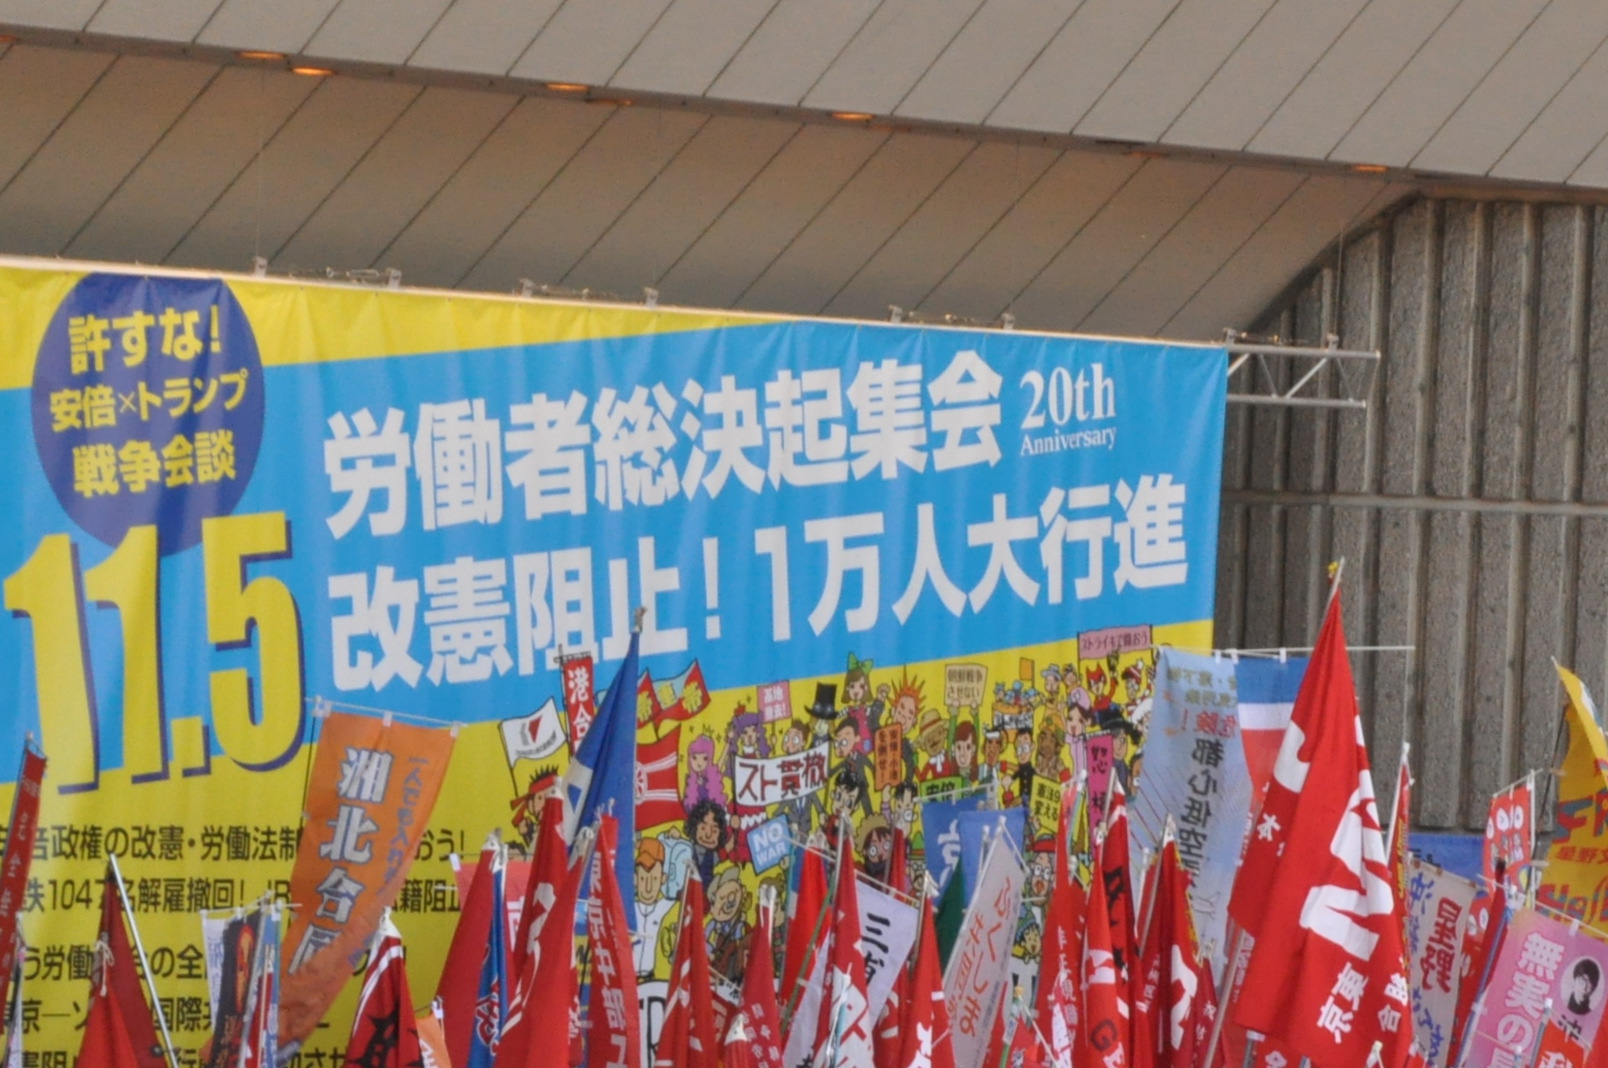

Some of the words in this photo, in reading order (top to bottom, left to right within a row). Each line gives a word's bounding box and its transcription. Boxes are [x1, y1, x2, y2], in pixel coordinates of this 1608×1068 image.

[1019, 364, 1116, 431] 20th
[73, 429, 236, 498] 戦争会談
[324, 350, 1003, 540] 労働者総決起集会
[1020, 426, 1116, 457] Anniversary
[3, 512, 300, 790] 11.5
[738, 753, 827, 802] スト貫徹
